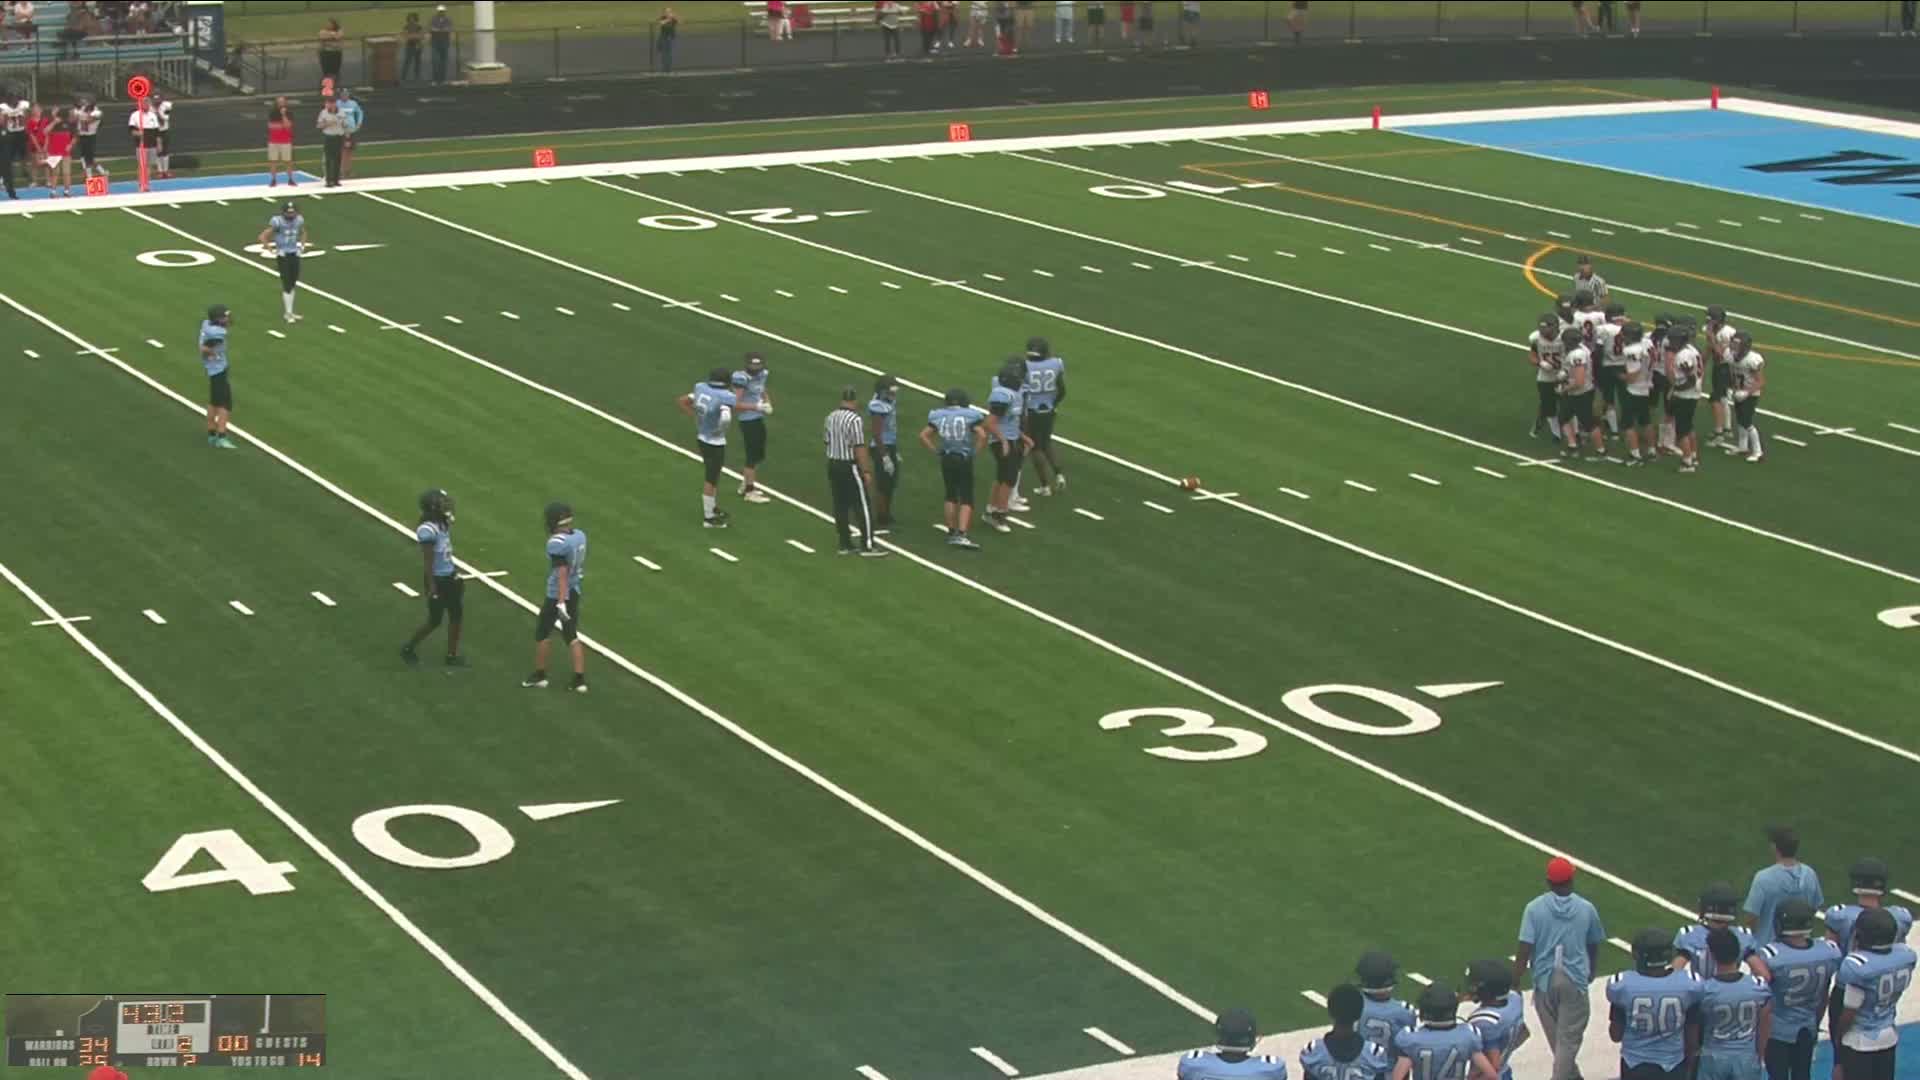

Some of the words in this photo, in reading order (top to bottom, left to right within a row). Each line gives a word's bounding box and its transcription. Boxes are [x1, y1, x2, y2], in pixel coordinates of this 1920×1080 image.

[1028, 369, 1057, 393] 52
[938, 415, 966, 442] 40
[1631, 996, 1683, 1035] 60
